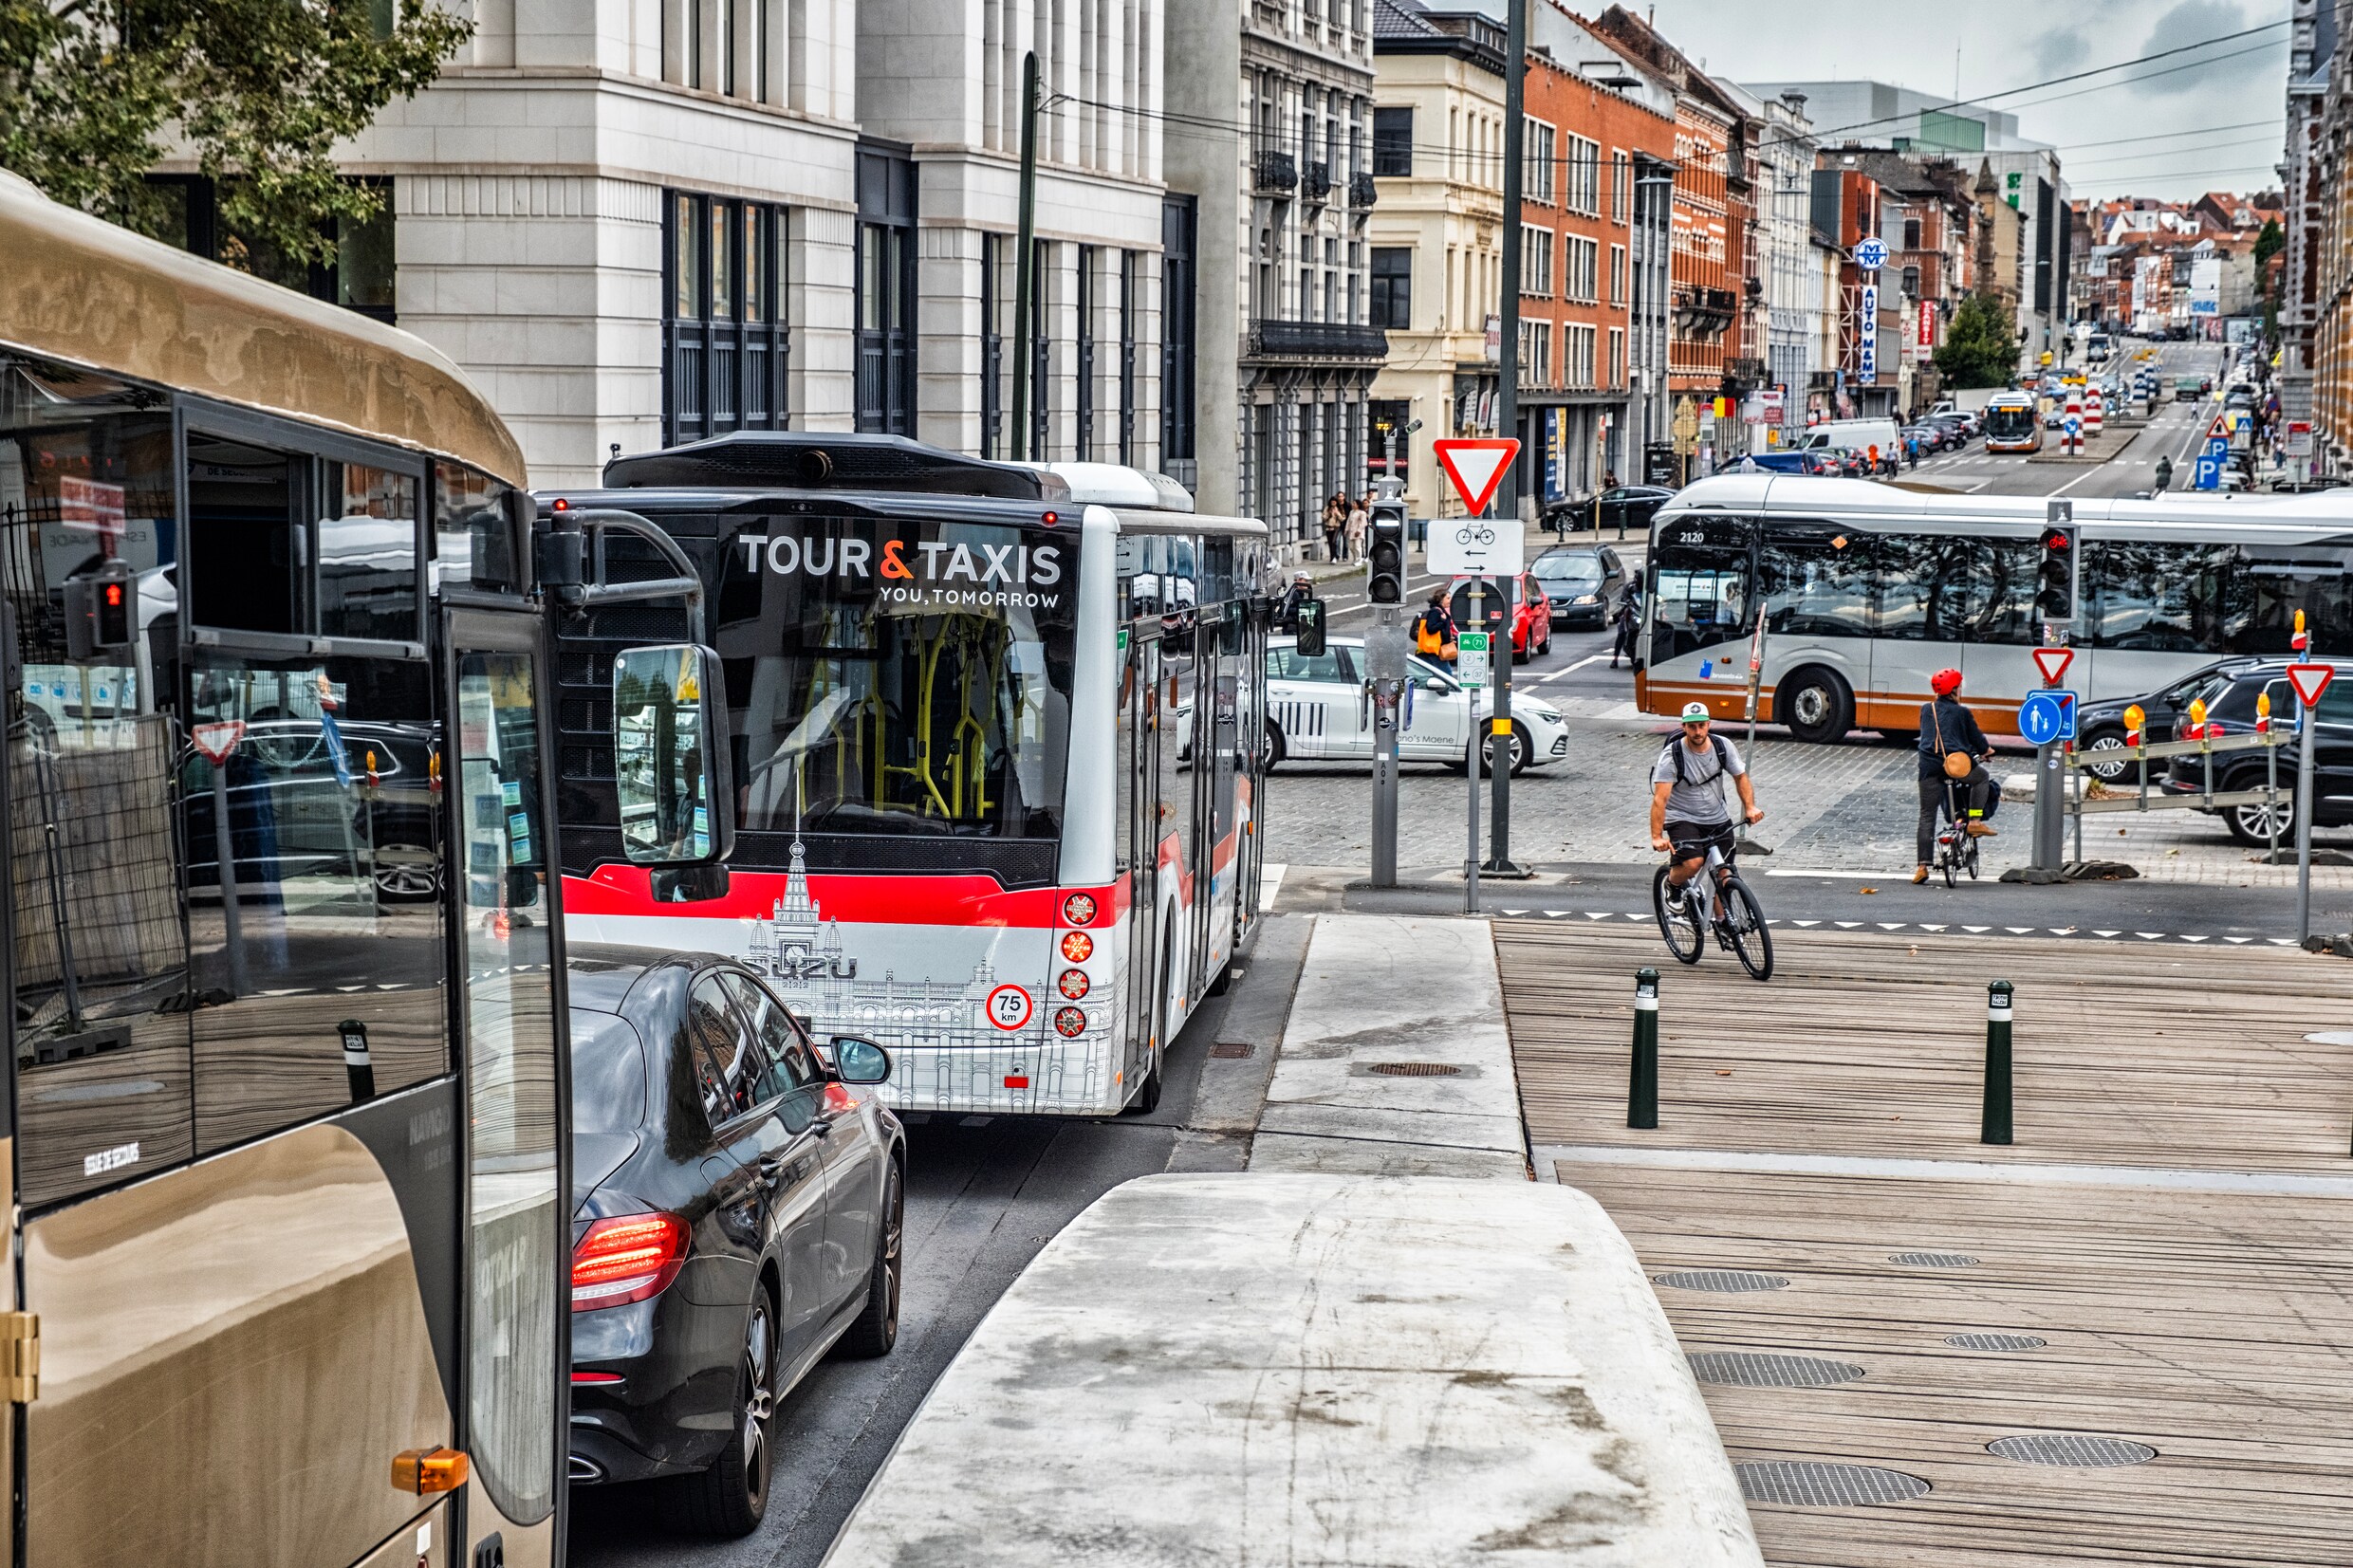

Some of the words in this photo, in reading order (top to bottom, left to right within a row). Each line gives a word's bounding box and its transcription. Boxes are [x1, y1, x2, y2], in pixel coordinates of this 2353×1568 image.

[1863, 244, 1880, 252] M
[1863, 256, 1880, 265] M
[1863, 288, 1876, 332] AUTO
[1921, 301, 1932, 344] TRANSIT
[1862, 339, 1875, 372] M&M
[2212, 442, 2225, 456] P
[2199, 461, 2216, 484] P
[1679, 532, 1704, 543] 2120
[739, 534, 871, 577] TOUR
[880, 539, 915, 580] &
[917, 541, 1061, 585] TAXIS
[731, 954, 857, 979] SUZU
[998, 995, 1021, 1011] 75
[1001, 1012, 1017, 1022] km
[83, 1152, 102, 1176] ISSUE
[102, 1150, 112, 1171] DE
[112, 1141, 139, 1168] SECOURS
